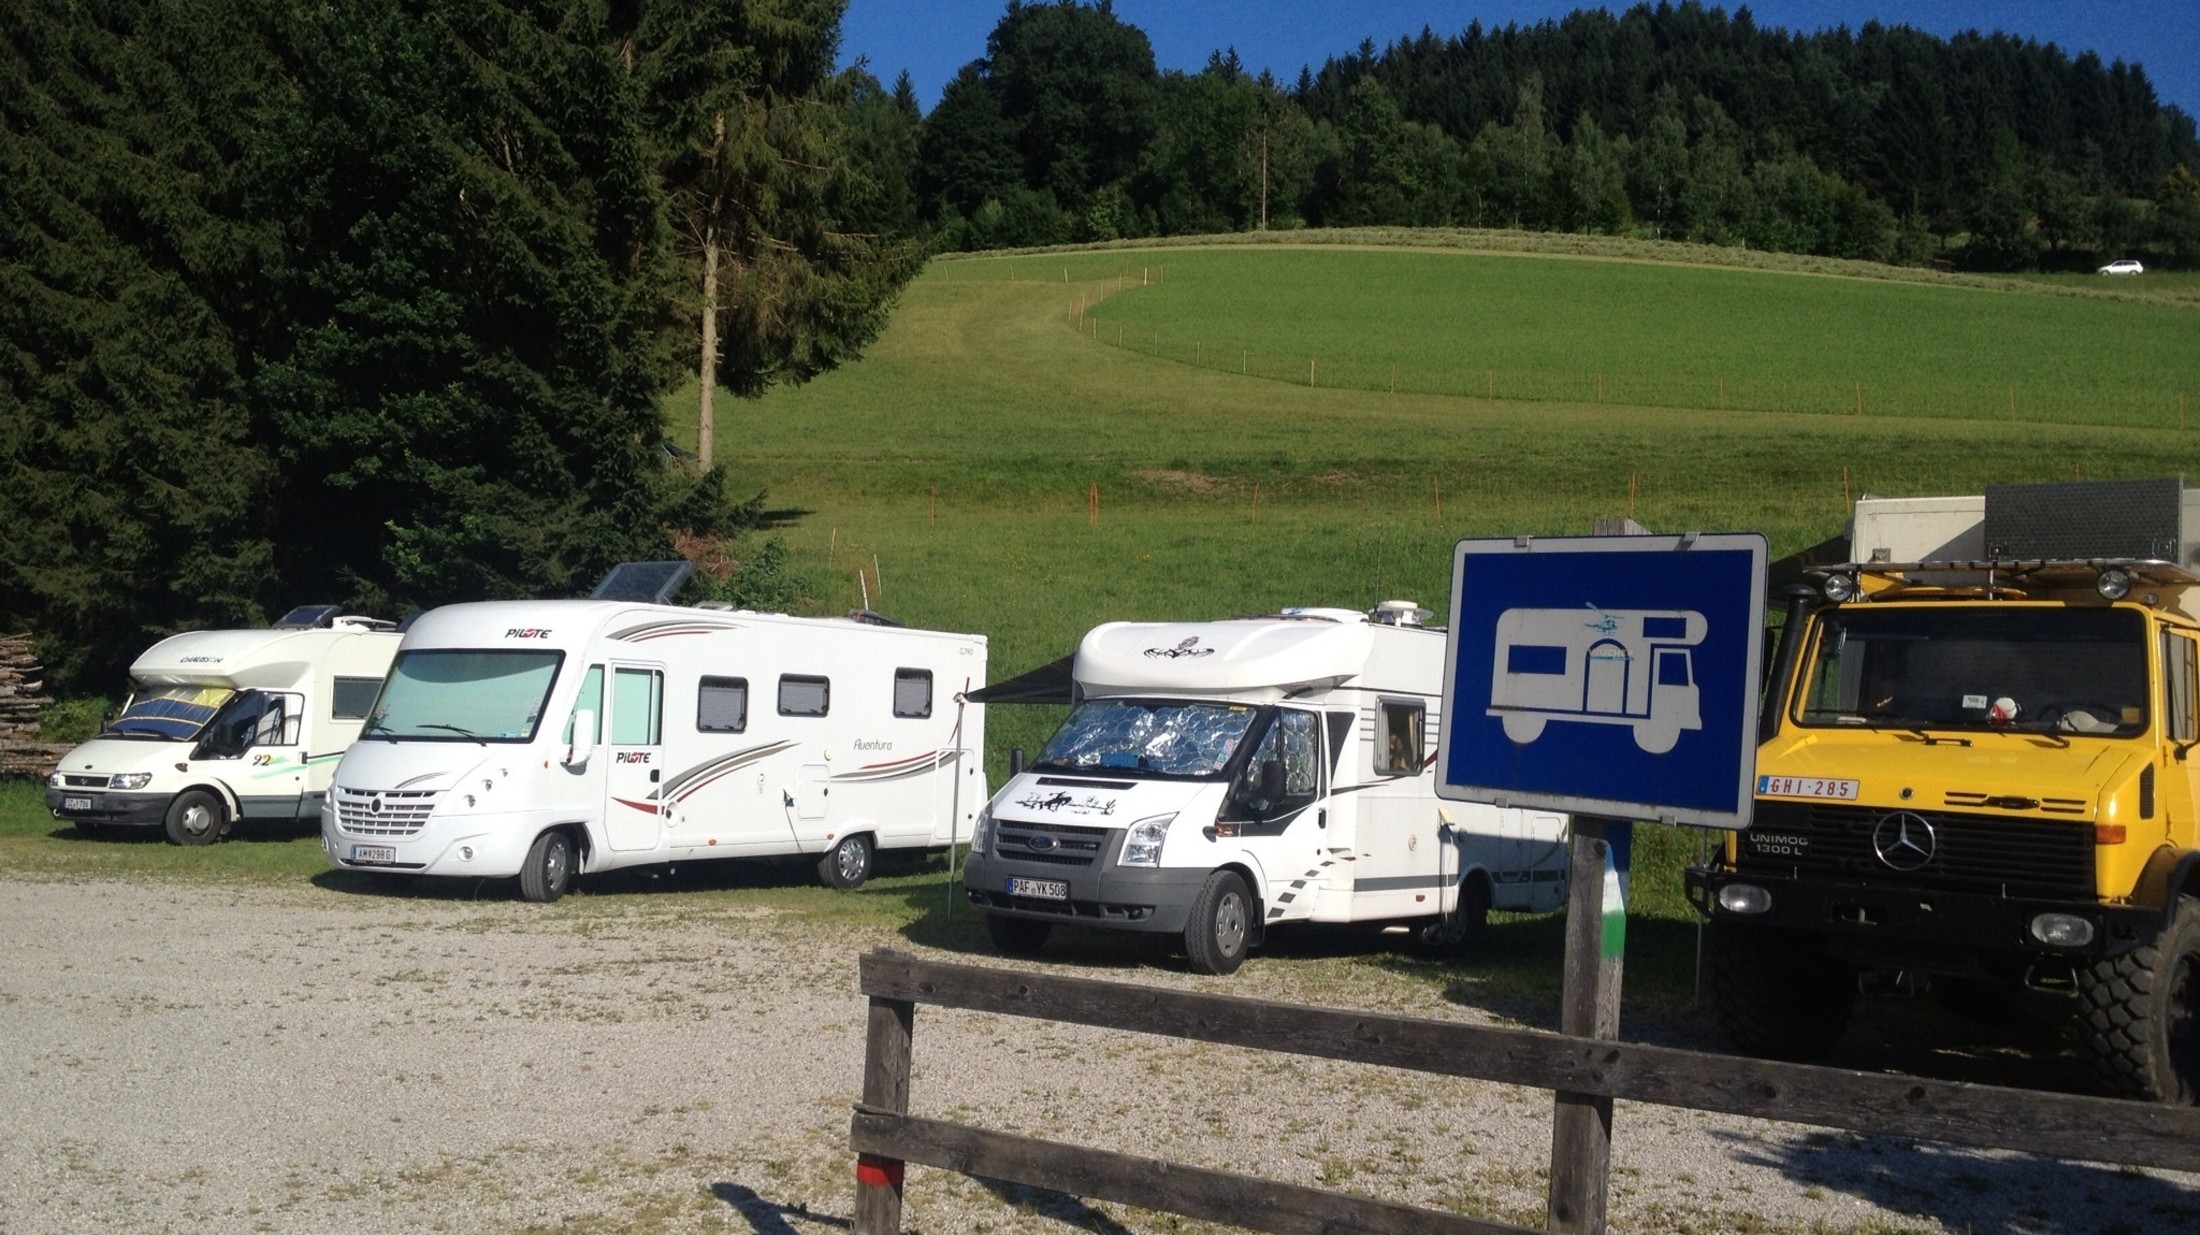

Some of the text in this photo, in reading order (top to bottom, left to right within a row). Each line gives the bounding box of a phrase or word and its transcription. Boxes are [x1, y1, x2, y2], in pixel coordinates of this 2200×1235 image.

[504, 628, 553, 639] PILOTE
[853, 738, 893, 751] Aventura
[615, 752, 651, 764] PILOTE
[1750, 833, 1809, 846] UNIMOG
[1756, 844, 1803, 856] 1300 L
[1013, 880, 1067, 897] PAF YK 508
